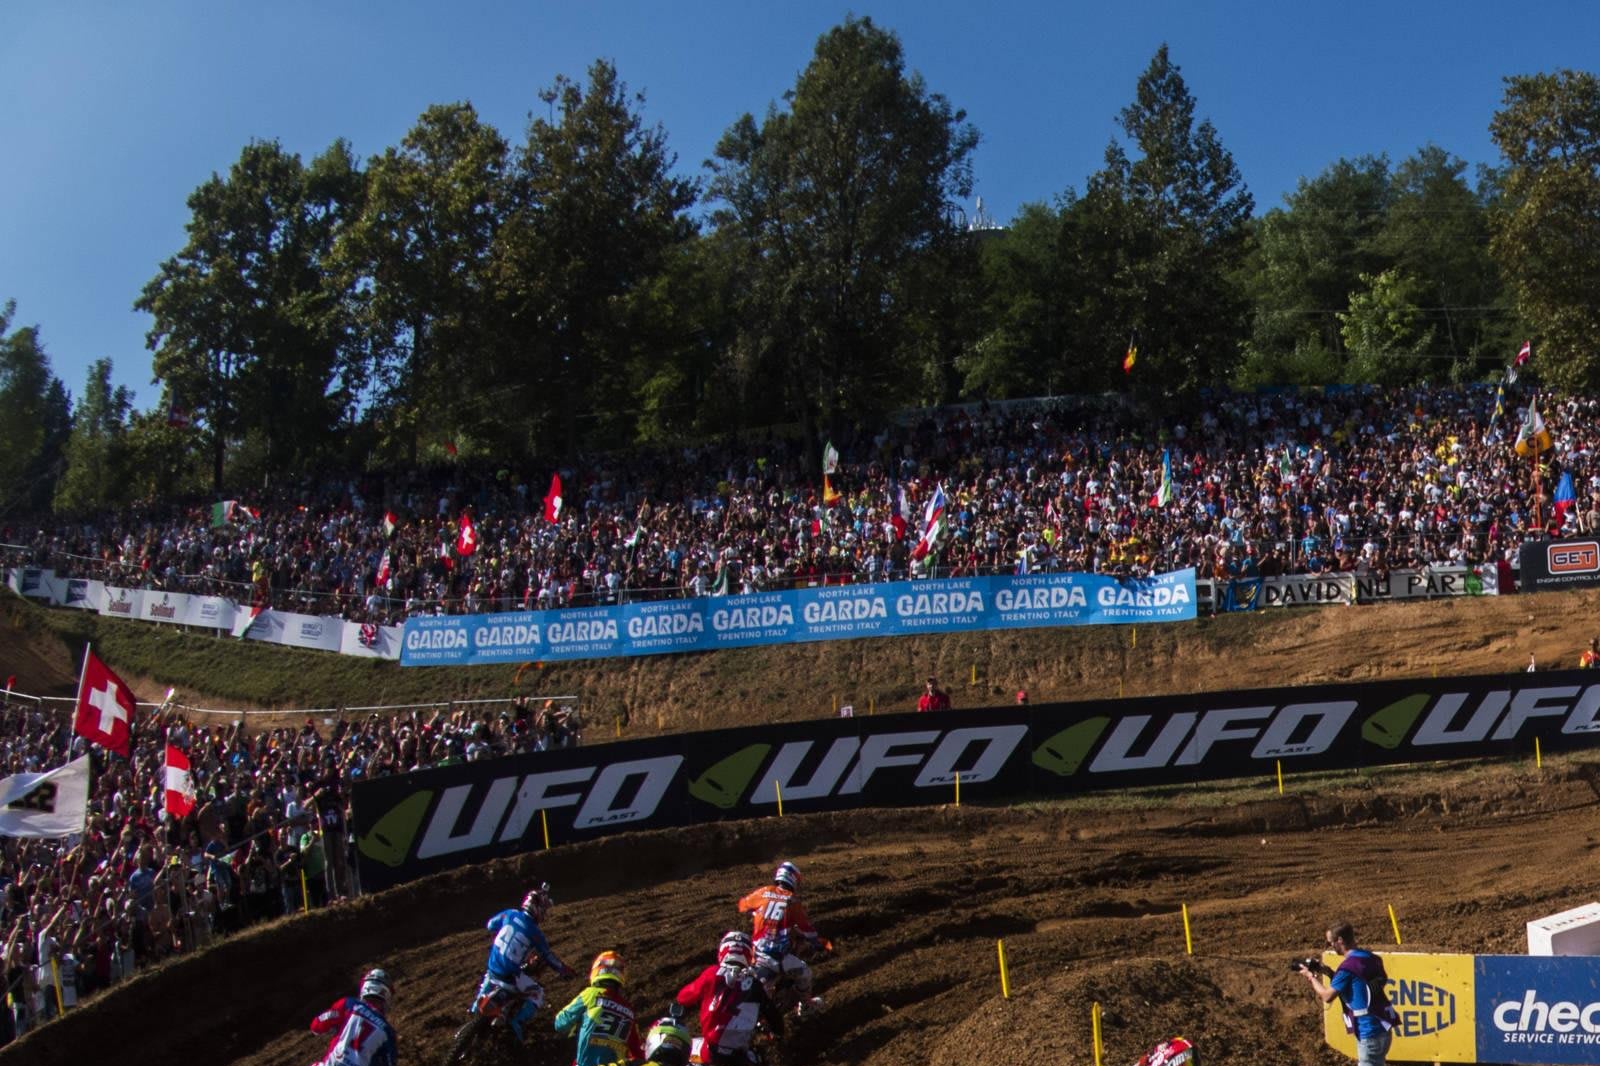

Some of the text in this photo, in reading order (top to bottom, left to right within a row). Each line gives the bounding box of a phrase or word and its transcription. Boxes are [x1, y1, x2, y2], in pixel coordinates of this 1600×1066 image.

[1553, 550, 1594, 566] GET
[912, 581, 971, 592] NORTH LAKE
[1012, 576, 1073, 586] NORTH LAKE
[819, 588, 875, 599] NORTH LAKE
[1097, 583, 1190, 607] GARDA
[1266, 582, 1341, 604] DAVID
[1358, 577, 1390, 599] NO
[727, 595, 782, 606] NORTH LAKE
[896, 591, 985, 617] GARDA
[996, 586, 1087, 611] GARDA
[641, 603, 692, 613] NORTH LAKE
[804, 597, 887, 623] GARDA
[1103, 606, 1183, 617] TRENTINO ITALY
[561, 610, 609, 620] NORTH LAKE
[713, 605, 794, 630] GARDA
[902, 616, 978, 626] TRENTINO ITALY
[1001, 610, 1080, 621] TRENTINO ITALY
[548, 620, 618, 643] GARDA
[628, 613, 704, 638] GARDA
[809, 622, 881, 633] TRENTINO ITALY
[407, 629, 468, 650] GARDA
[475, 625, 541, 647] GARDA
[717, 629, 788, 640] TRENTINO ITALY
[551, 643, 613, 653] TRENTINO ITALY
[632, 636, 697, 648] TRENTINO ITALY
[1089, 700, 1358, 773] UFO
[1265, 745, 1316, 756] PLAST
[751, 724, 1028, 804] UFO
[929, 773, 981, 785] PLAST
[416, 754, 685, 859] UFO
[588, 811, 641, 824] PLAST
[764, 902, 788, 920] 16
[1503, 1033, 1554, 1044] SERVICE
